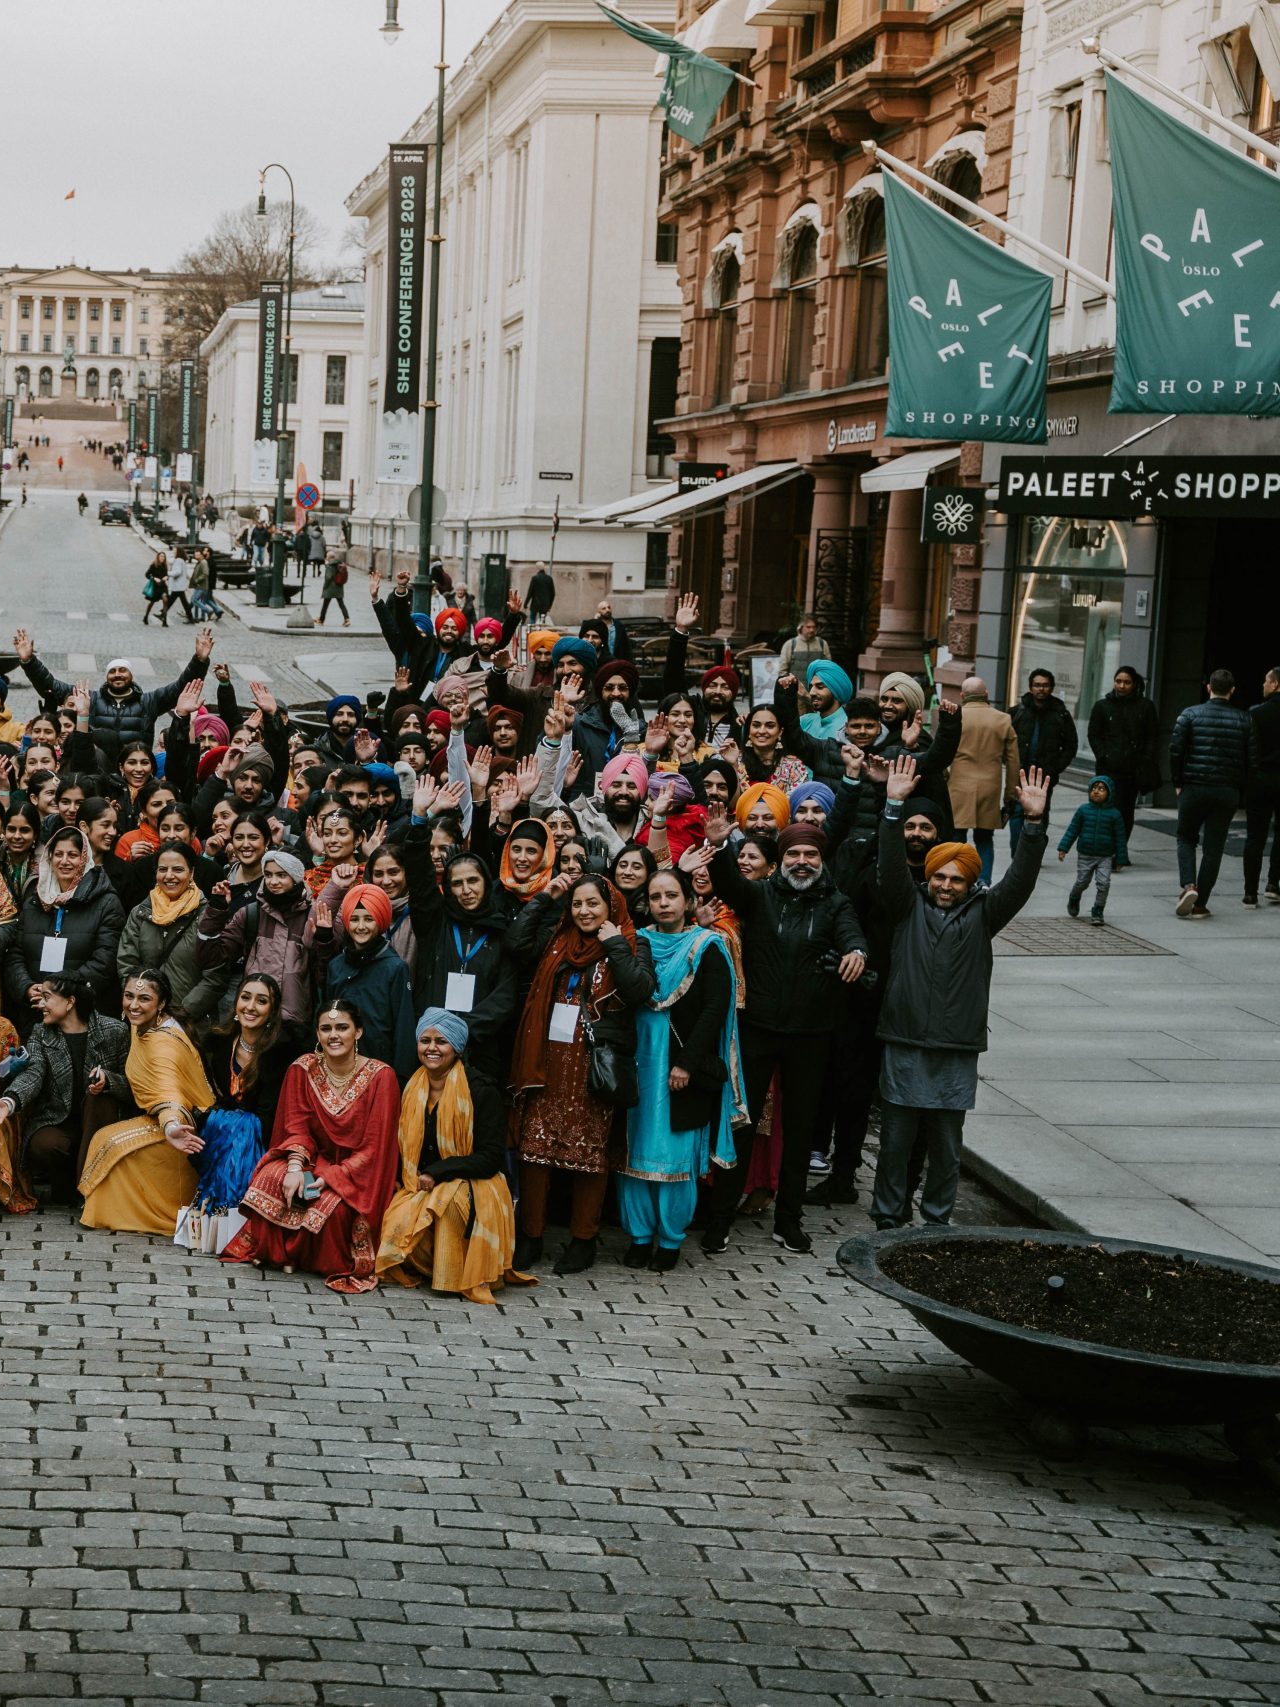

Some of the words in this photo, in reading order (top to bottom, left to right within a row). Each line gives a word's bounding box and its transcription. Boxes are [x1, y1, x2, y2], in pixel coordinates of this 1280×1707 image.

[400, 175, 415, 223] 2023
[1183, 266, 1220, 276] OSLO
[398, 227, 414, 352] CONFERENCE
[266, 300, 276, 329] 2023
[941, 322, 970, 333] OSLO
[263, 330, 275, 405] CONFERENCE
[397, 357, 410, 394] SHE
[262, 407, 272, 430] SHE
[906, 411, 1036, 429] SHOPPING
[1046, 415, 1077, 437] SMYKKER
[1007, 472, 1115, 497] PALEET
[1072, 593, 1097, 607] LUXURY
